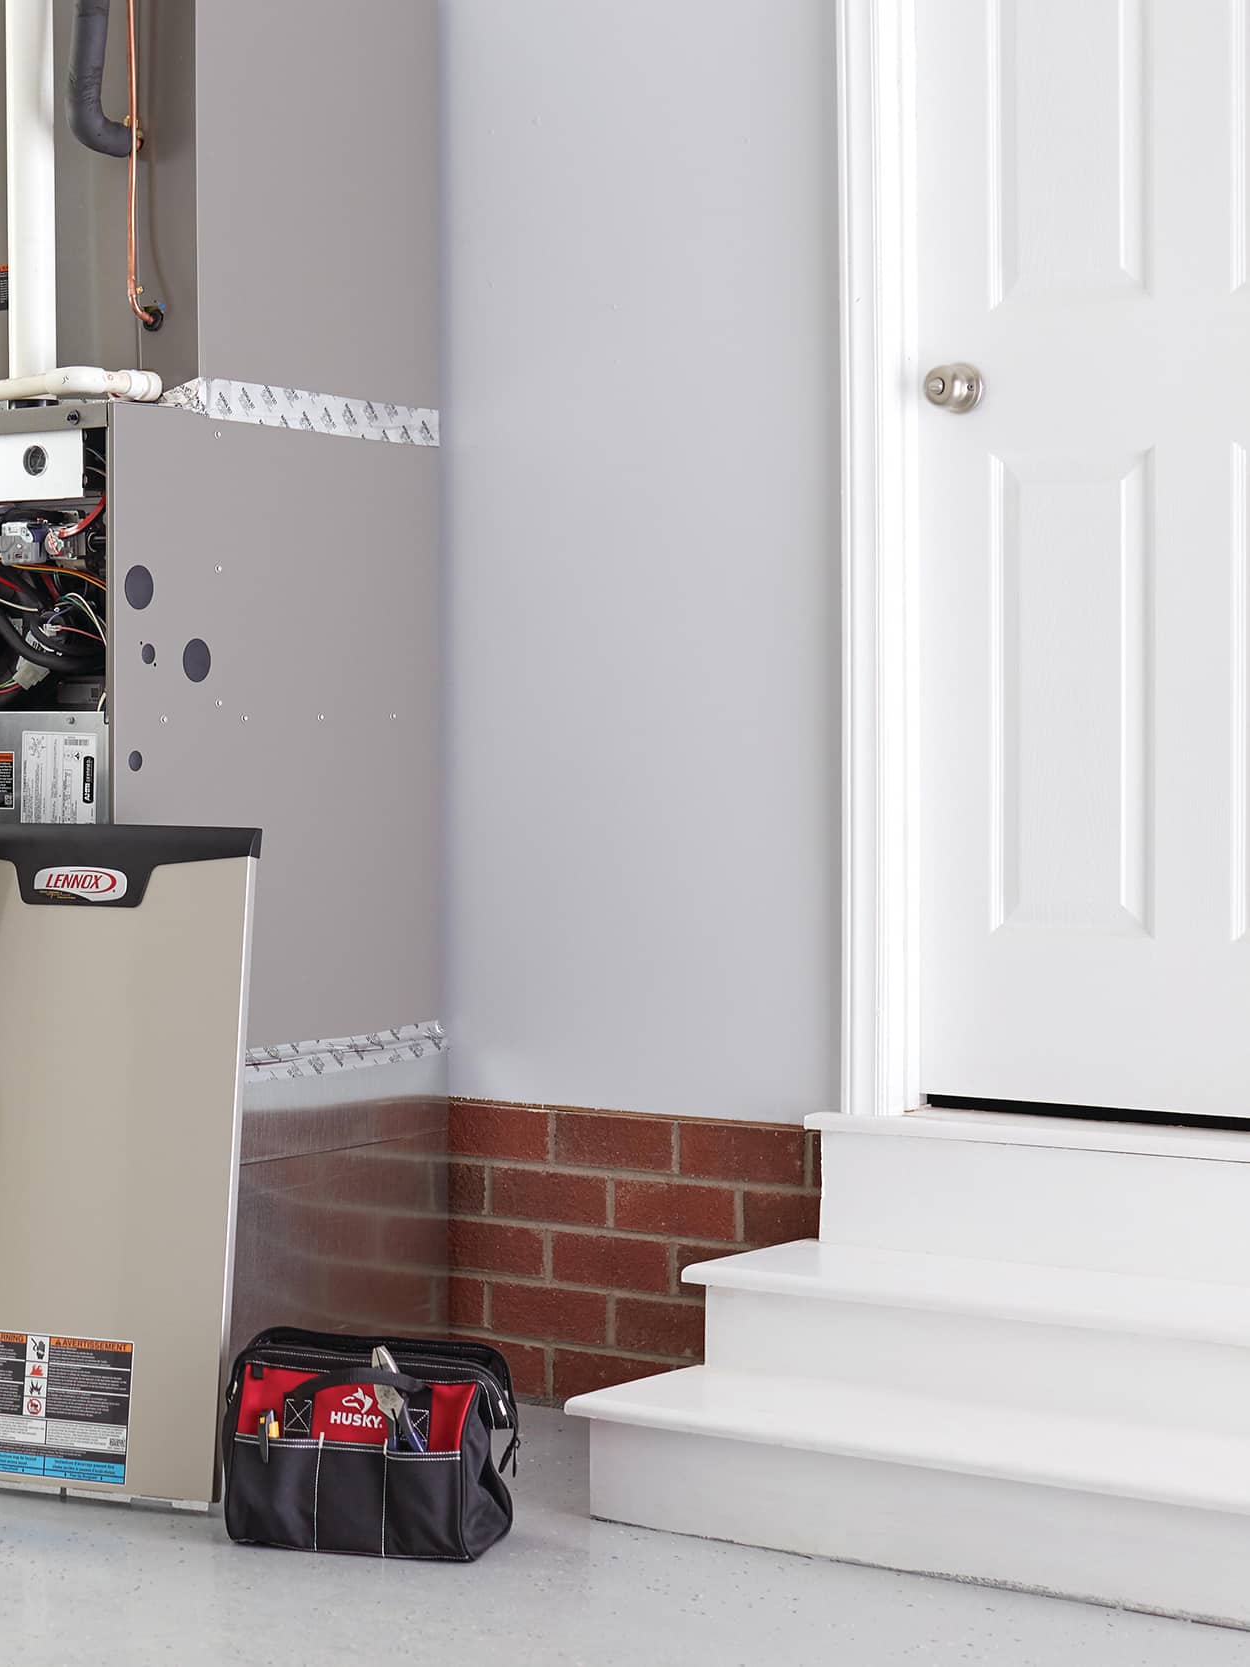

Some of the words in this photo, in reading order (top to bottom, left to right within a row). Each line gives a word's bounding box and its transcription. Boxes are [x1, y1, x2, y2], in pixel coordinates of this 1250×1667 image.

[45, 873, 103, 889] LENNOX
[62, 1339, 127, 1352] AVERTISSEMENT
[330, 1411, 382, 1428] HUSKY
